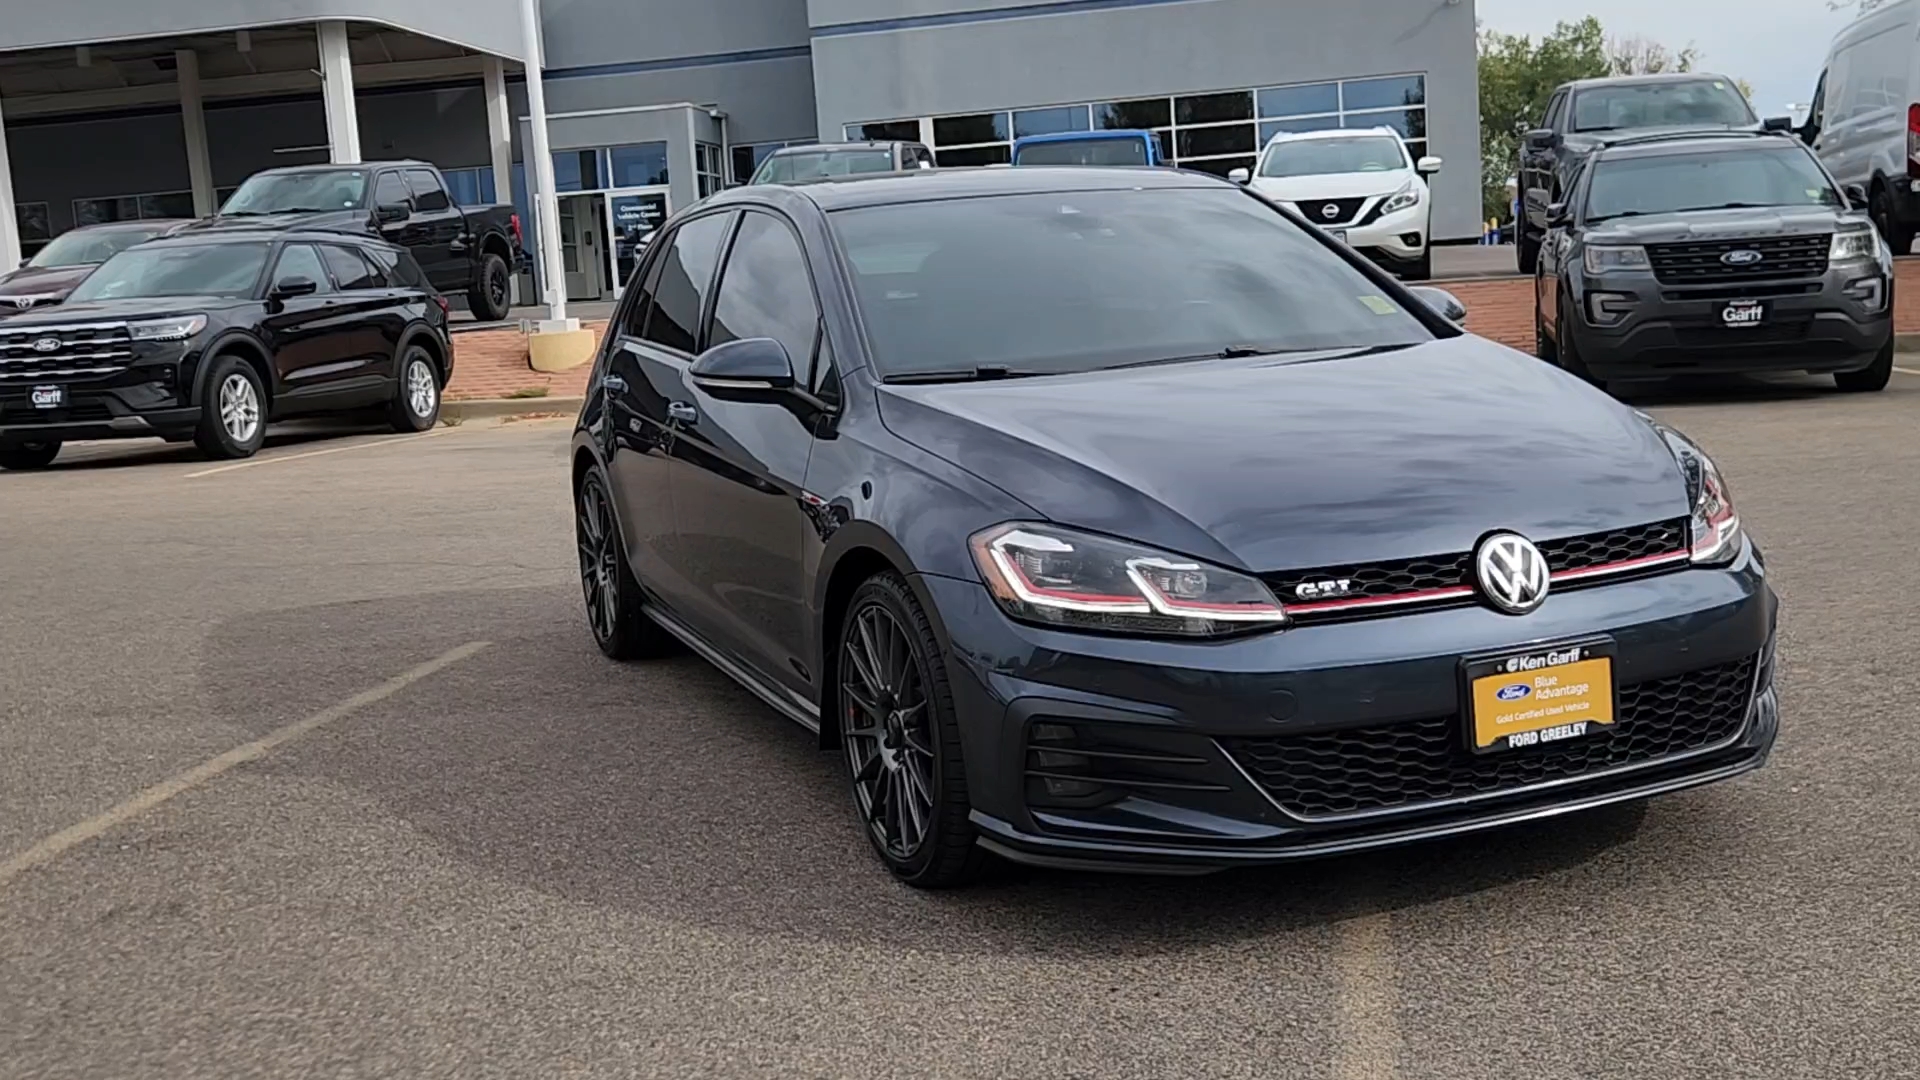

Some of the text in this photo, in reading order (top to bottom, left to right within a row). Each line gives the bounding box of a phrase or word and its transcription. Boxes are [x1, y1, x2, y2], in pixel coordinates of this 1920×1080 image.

[1722, 305, 1763, 322] Garff
[31, 389, 62, 404] Garff
[1295, 579, 1350, 599] GTI
[1519, 648, 1581, 671] Ken Garff
[1534, 676, 1558, 688] Blue
[1535, 682, 1589, 700] Advantage
[1501, 685, 1526, 699] Ford
[1496, 702, 1590, 724] Gold Certified Used Vehicle
[1508, 722, 1588, 748] FORD GREELEY
